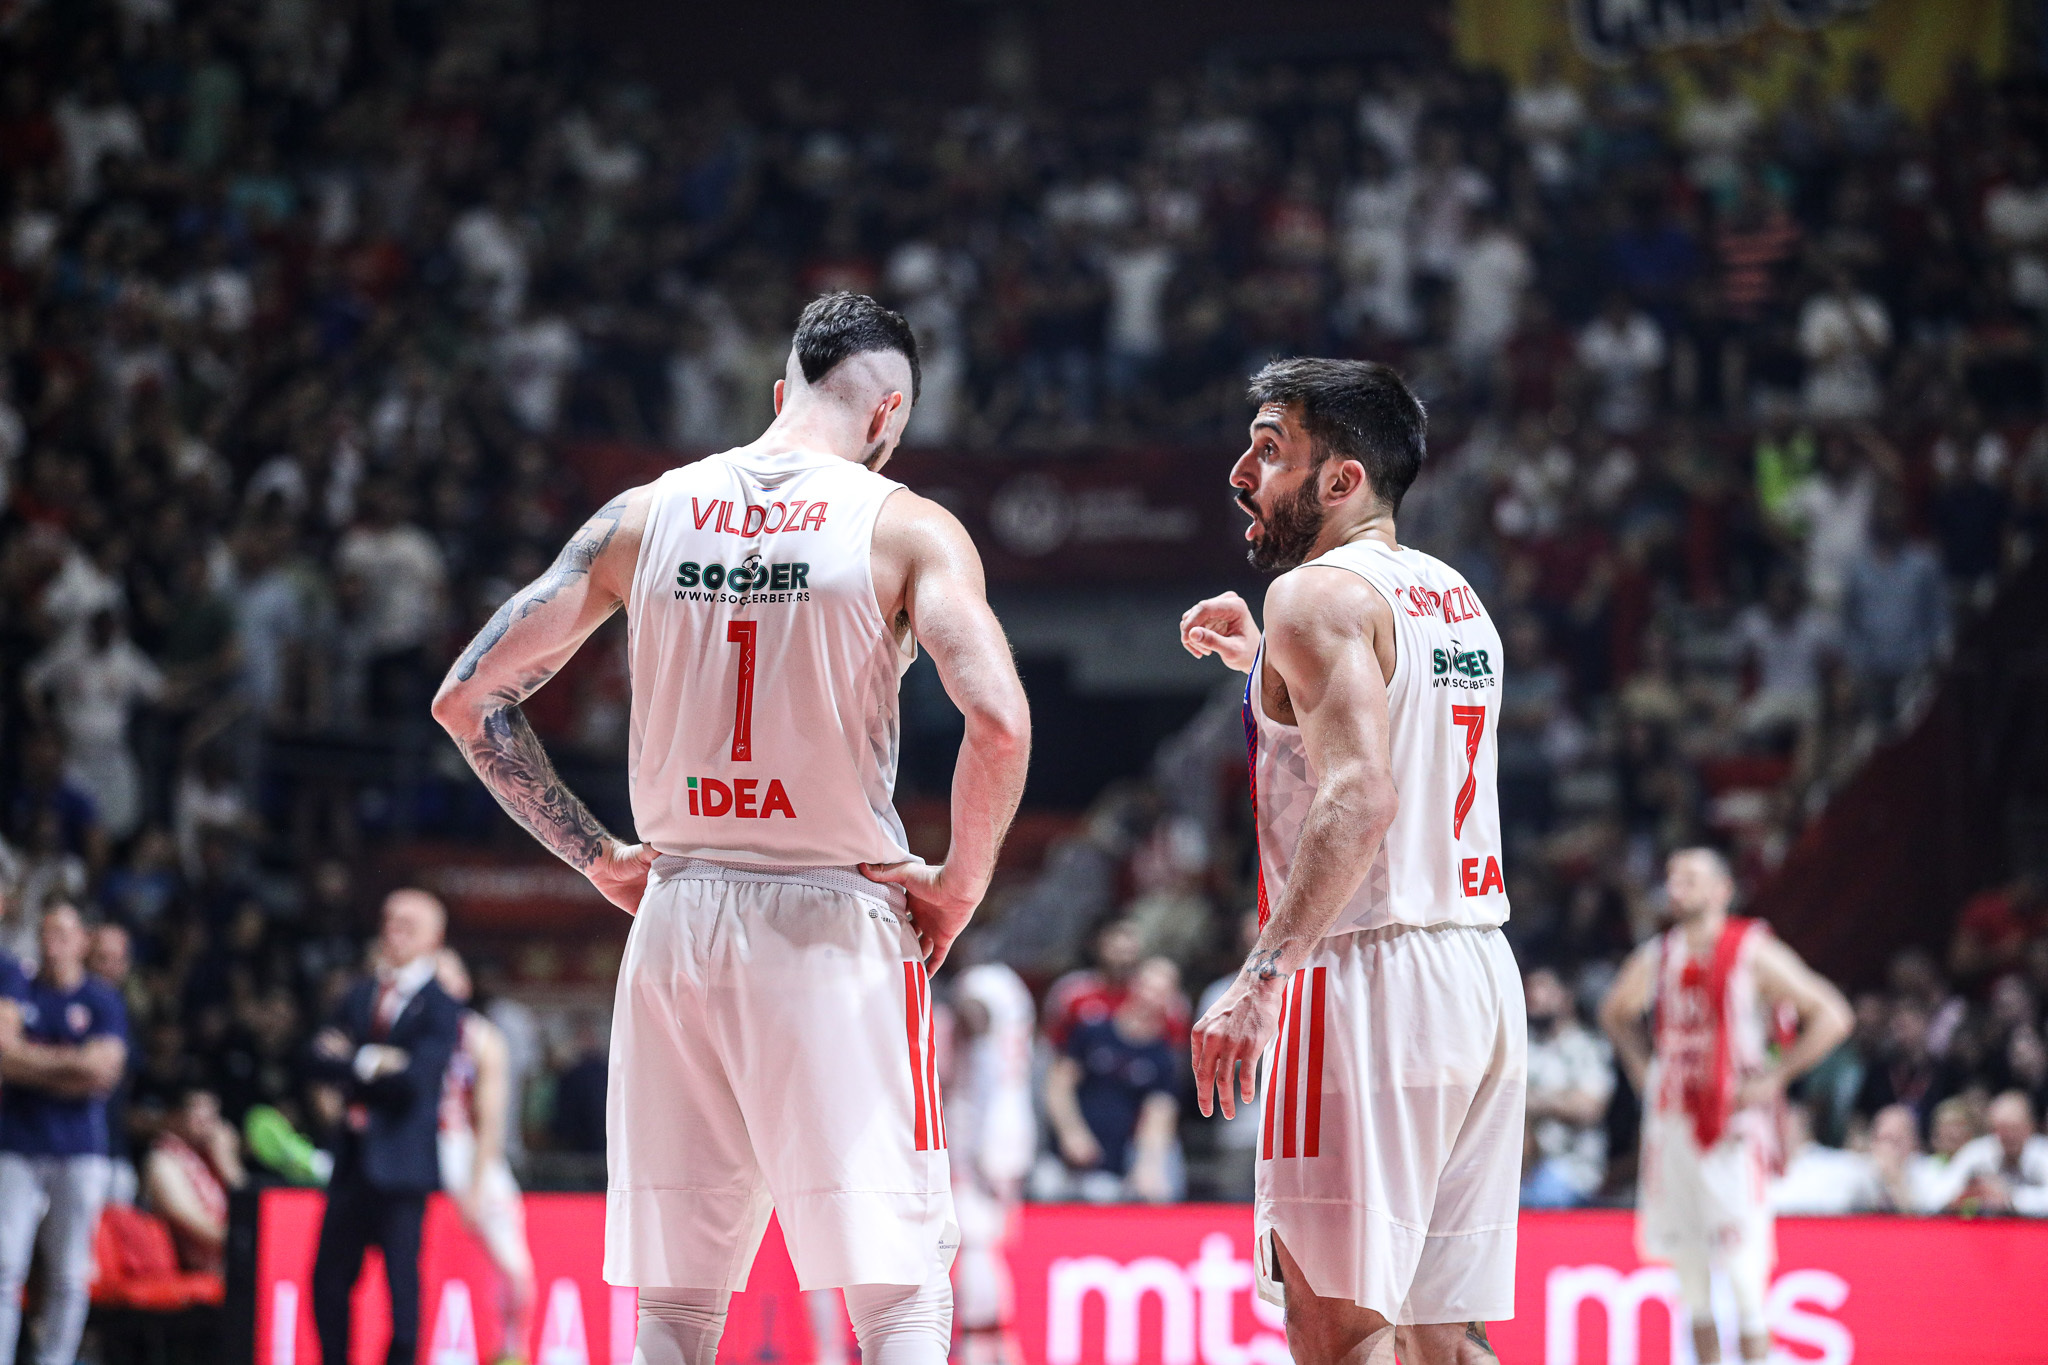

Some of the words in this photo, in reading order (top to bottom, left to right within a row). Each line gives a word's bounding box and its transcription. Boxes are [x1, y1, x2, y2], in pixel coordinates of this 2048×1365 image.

[691, 497, 829, 538] VILDOZA
[727, 620, 757, 762] 1
[1452, 704, 1486, 841] 7
[1543, 1263, 1854, 1365] ms
